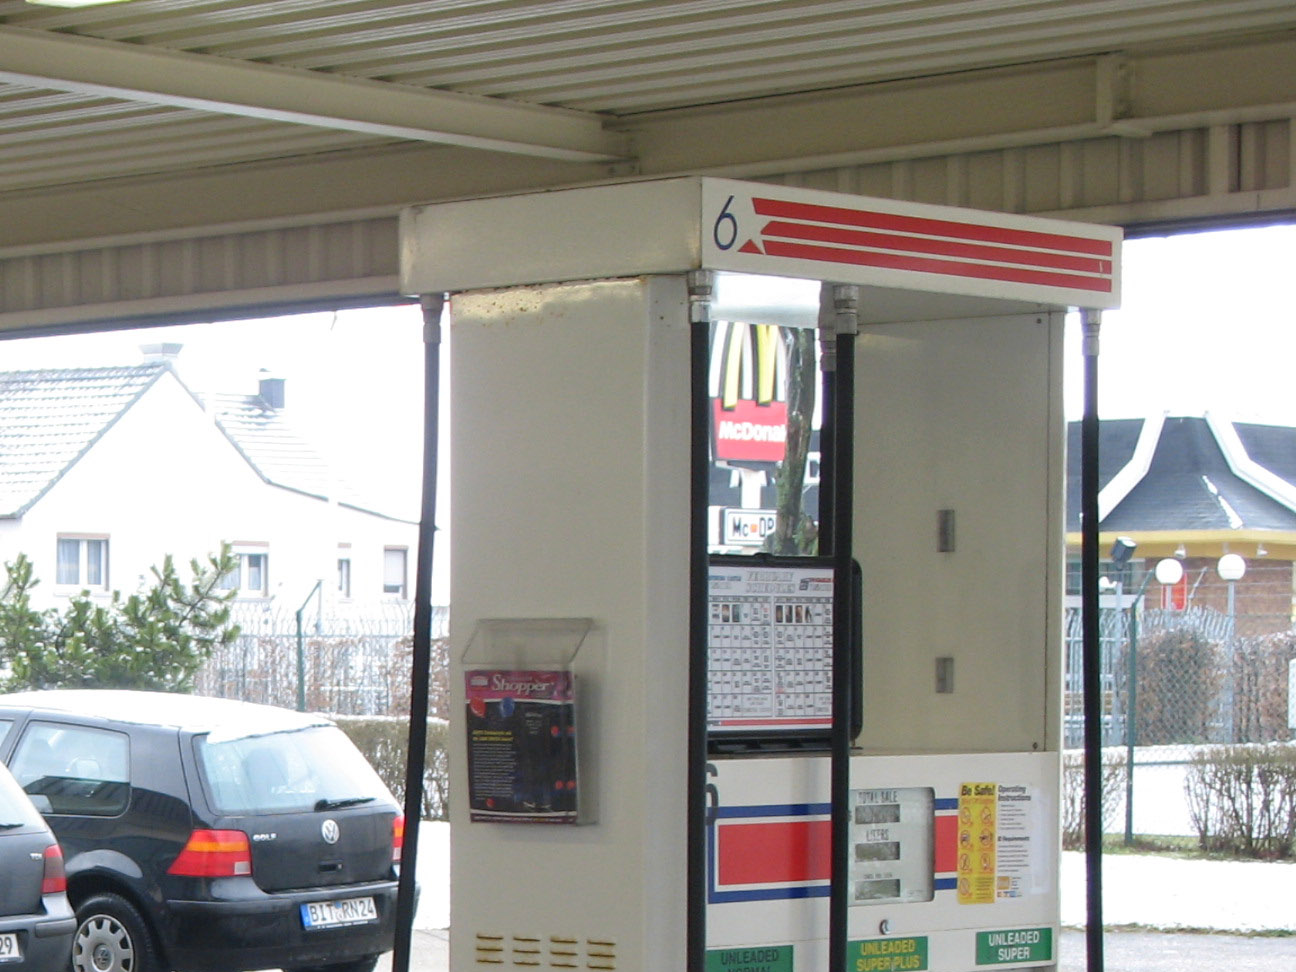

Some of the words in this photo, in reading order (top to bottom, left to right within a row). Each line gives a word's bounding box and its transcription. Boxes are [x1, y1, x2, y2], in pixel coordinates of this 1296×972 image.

[713, 194, 738, 251] 6
[491, 673, 551, 696] Shopper
[881, 790, 898, 803] SALE
[961, 785, 972, 796] Be
[973, 784, 996, 796] Safe!
[997, 784, 1027, 795] Operating
[997, 794, 1032, 802] Instructions
[253, 832, 278, 842] GOLF
[309, 902, 336, 923] BIT
[987, 930, 1041, 947] UNLEADED
[860, 938, 917, 956] UNLEADED
[997, 946, 1032, 962] SUPER
[720, 949, 780, 966] UNLEADED
